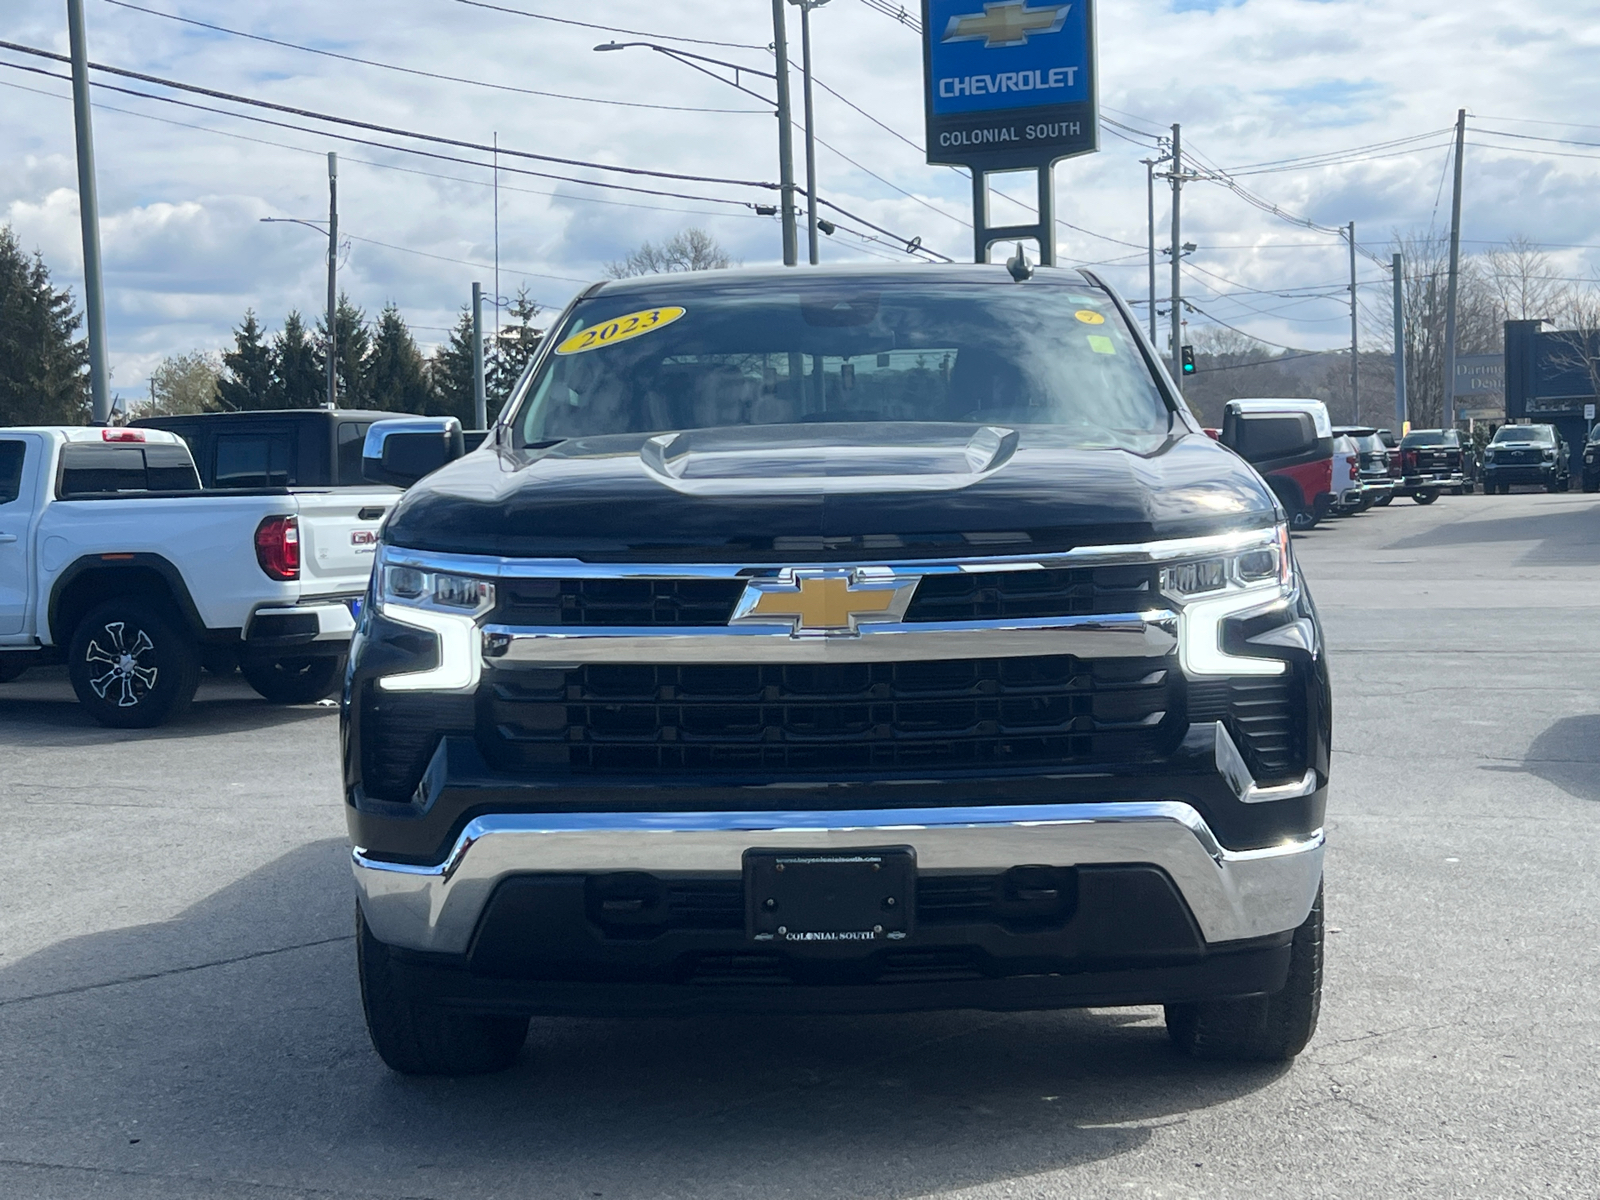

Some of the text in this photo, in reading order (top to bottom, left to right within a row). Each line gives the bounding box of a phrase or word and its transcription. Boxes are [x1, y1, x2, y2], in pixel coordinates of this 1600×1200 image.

[939, 66, 1078, 98] CHEVROLET
[939, 121, 1081, 147] COLONIAL SOUTH
[578, 311, 660, 349] 2023
[785, 931, 875, 941] COLONIAL SOUTH
